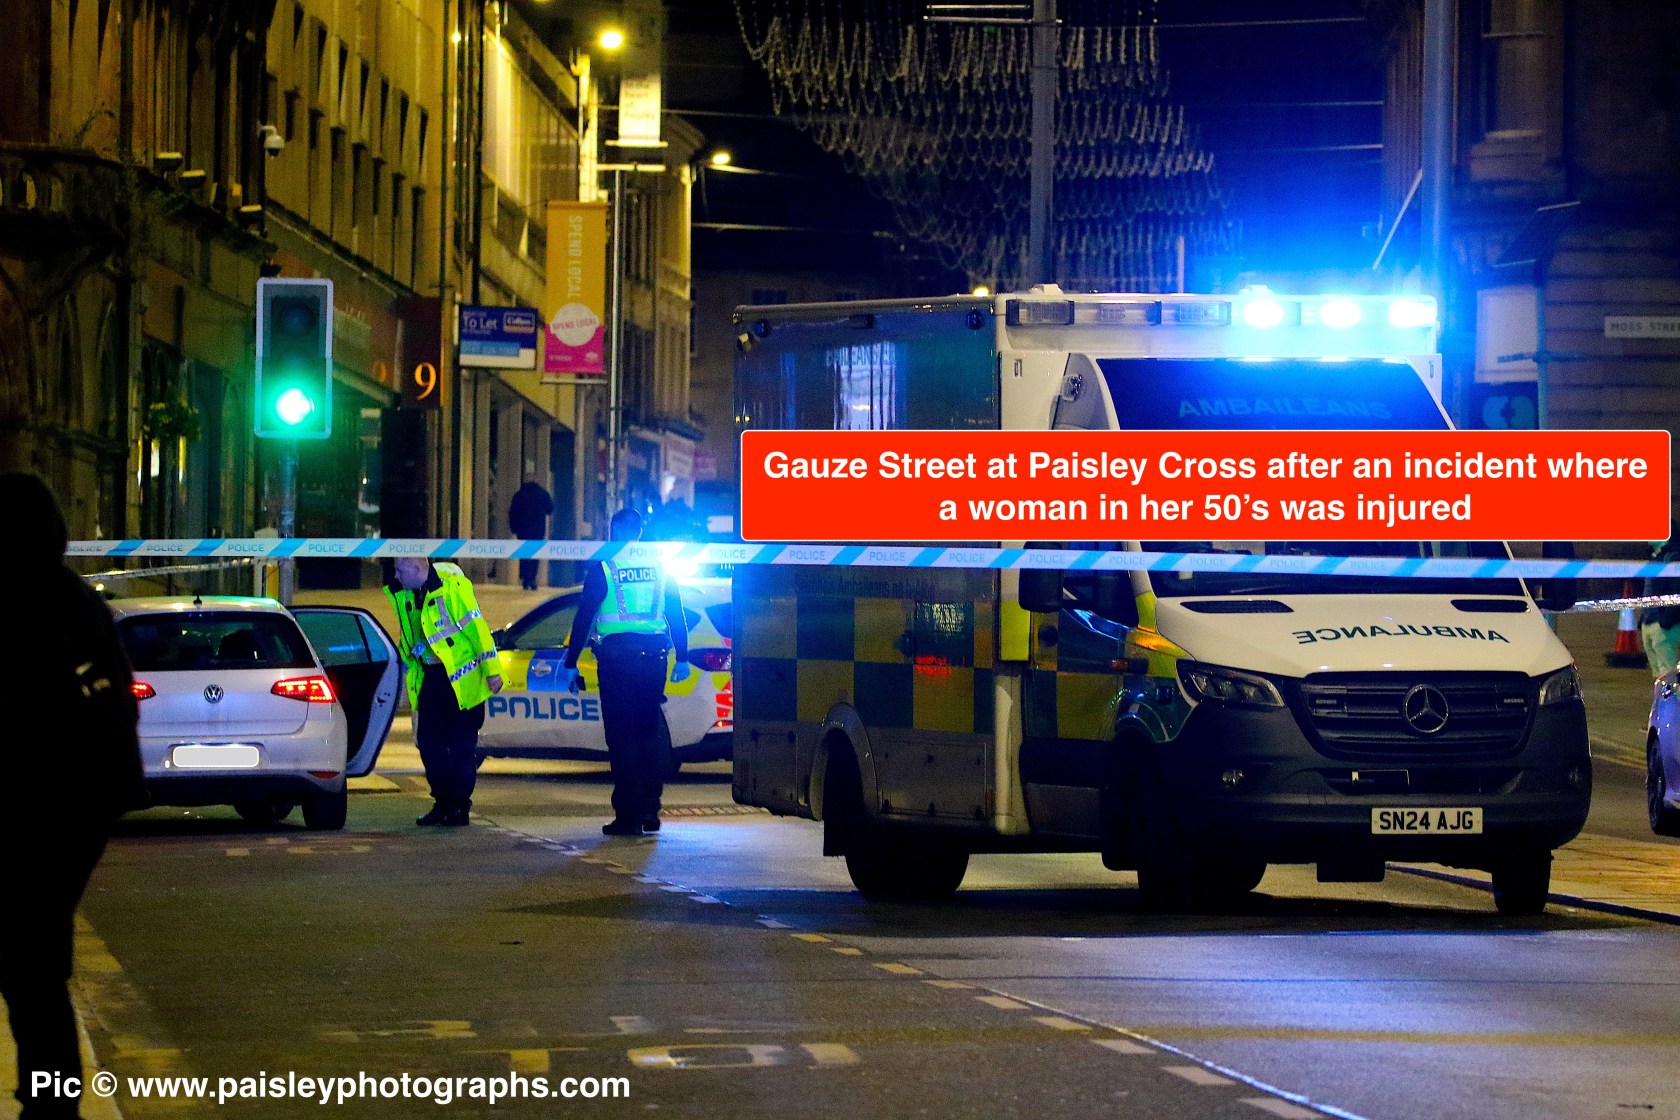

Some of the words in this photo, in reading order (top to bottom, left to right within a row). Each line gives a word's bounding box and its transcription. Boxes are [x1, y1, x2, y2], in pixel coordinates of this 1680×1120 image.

[568, 215, 582, 257] SPEND
[567, 260, 582, 298] LOCAL
[1611, 322, 1643, 331] MOSS
[414, 362, 437, 400] 9
[1179, 399, 1393, 419] AMBAILEANS
[147, 544, 184, 552] POLICE
[228, 544, 265, 552] POLICE
[308, 544, 345, 553] POLICE
[389, 544, 425, 553] POLICE
[469, 545, 506, 554] POLICE
[550, 545, 586, 555] POLICE
[789, 550, 826, 560] POLICE
[869, 551, 906, 561] POLICE
[950, 553, 985, 563] POLICE
[1029, 554, 1065, 564] POLICE
[1109, 556, 1145, 565] POLICE
[1189, 557, 1226, 567] POLICE
[1270, 559, 1306, 568] POLICE
[619, 567, 656, 581] POLICE
[488, 697, 600, 721] POLICE
[1379, 811, 1431, 831] SN24
[1437, 811, 1473, 831] AJG
